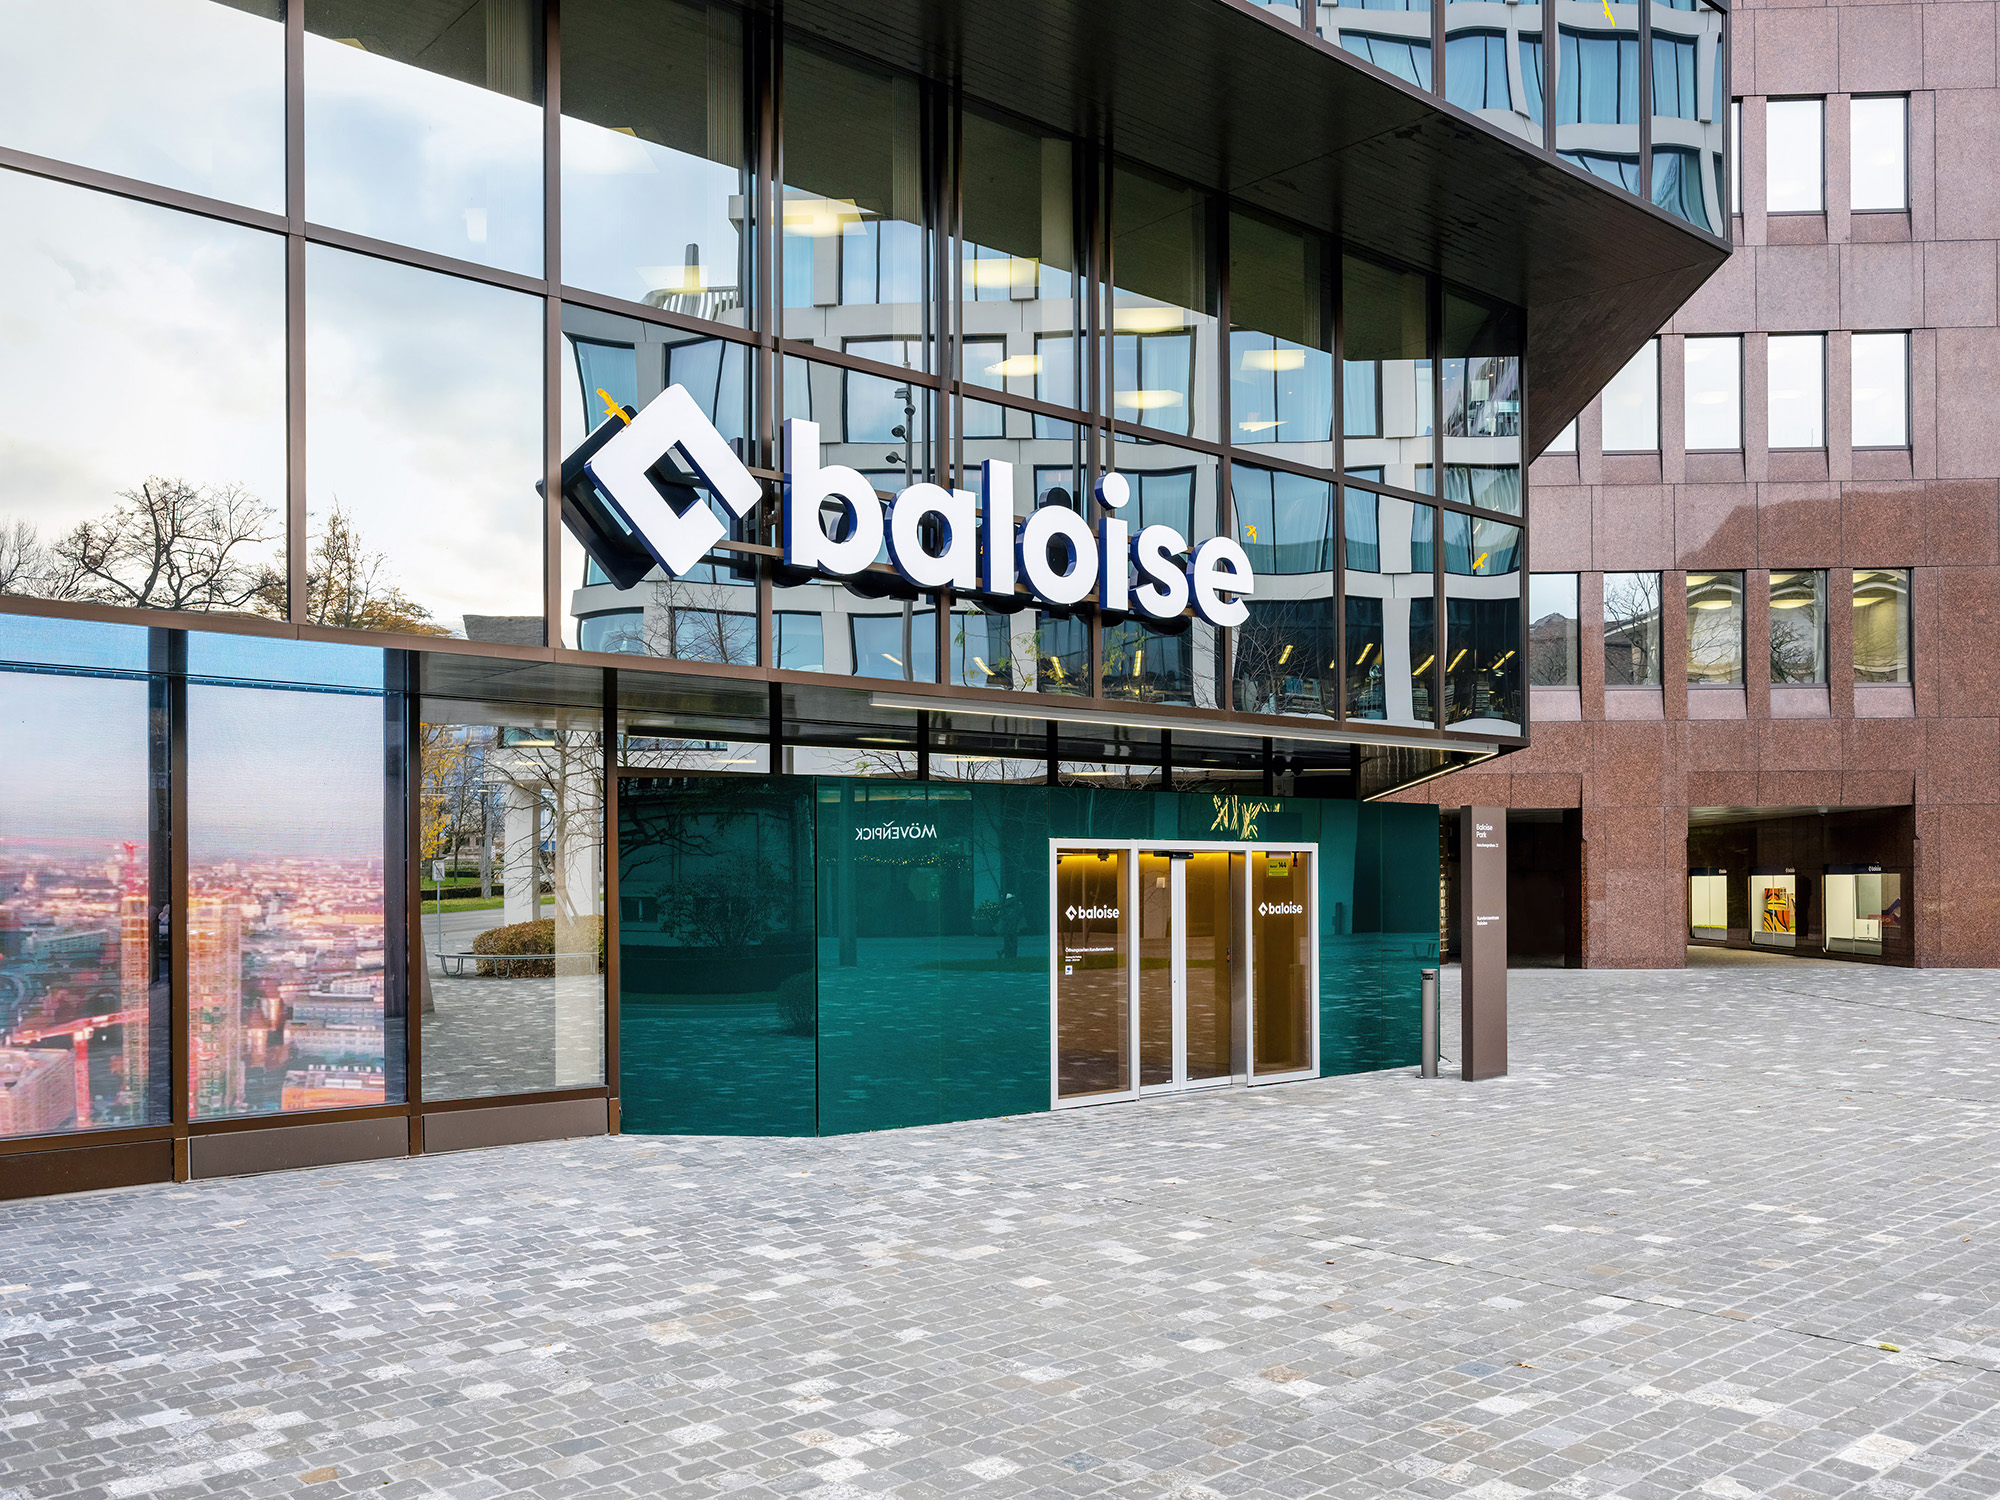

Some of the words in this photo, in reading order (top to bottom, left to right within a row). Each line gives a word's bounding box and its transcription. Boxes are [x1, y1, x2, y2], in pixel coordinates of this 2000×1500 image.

[783, 418, 1256, 627] baloise
[1476, 823, 1493, 831] Baloise
[1078, 905, 1120, 919] baloise
[1269, 901, 1303, 915] baloise
